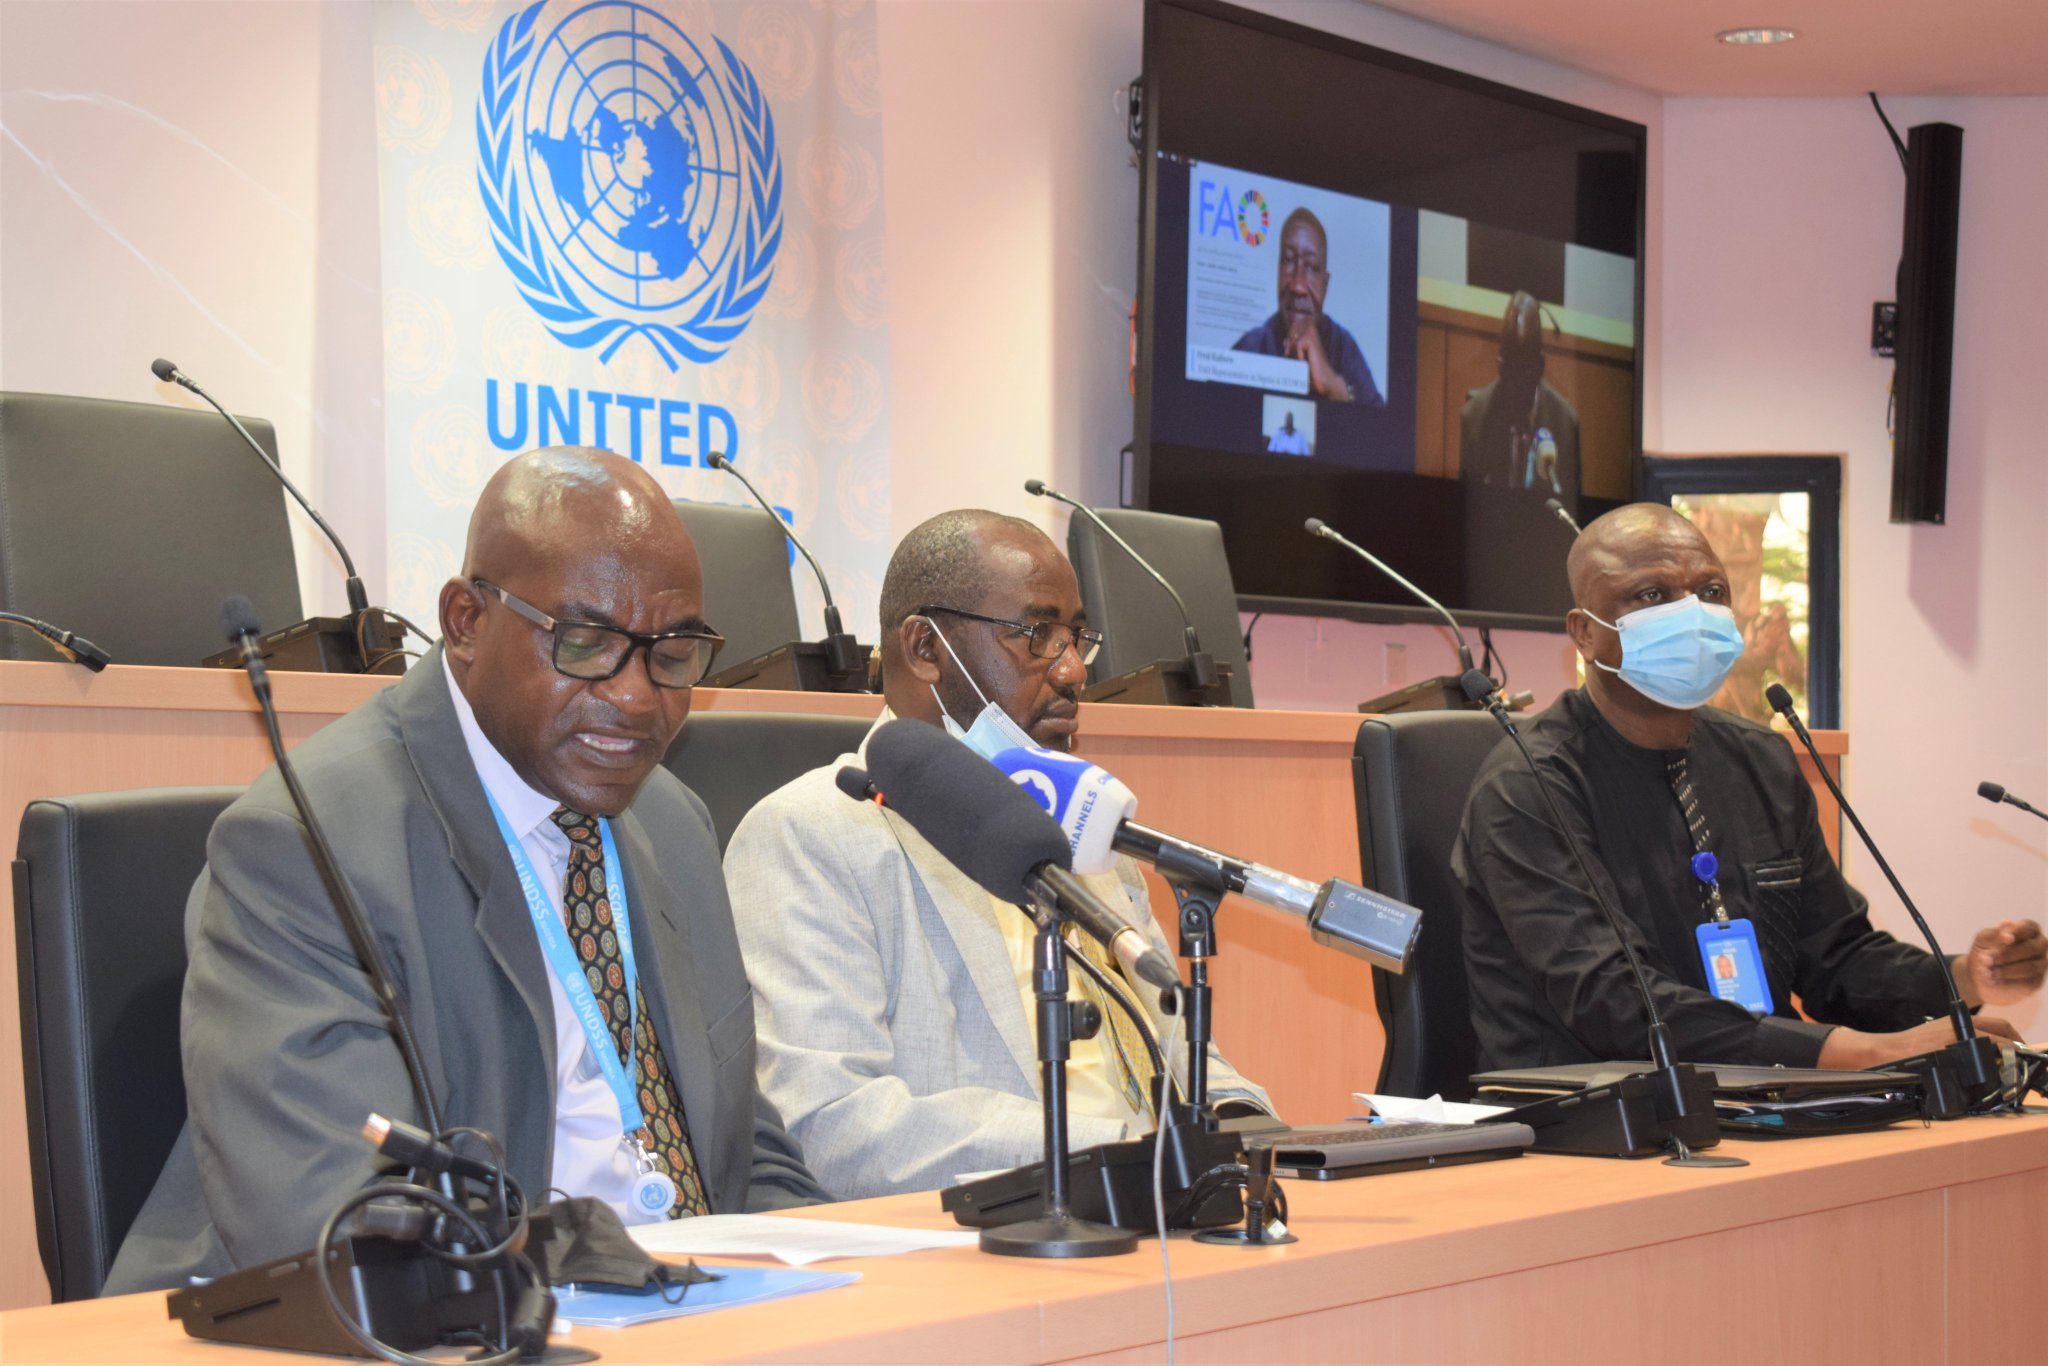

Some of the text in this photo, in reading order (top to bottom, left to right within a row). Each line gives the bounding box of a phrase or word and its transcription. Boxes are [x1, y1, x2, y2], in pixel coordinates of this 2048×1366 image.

[1199, 180, 1270, 247] FAO
[486, 378, 738, 470] UNITED
[575, 991, 608, 1051] UNDSS
